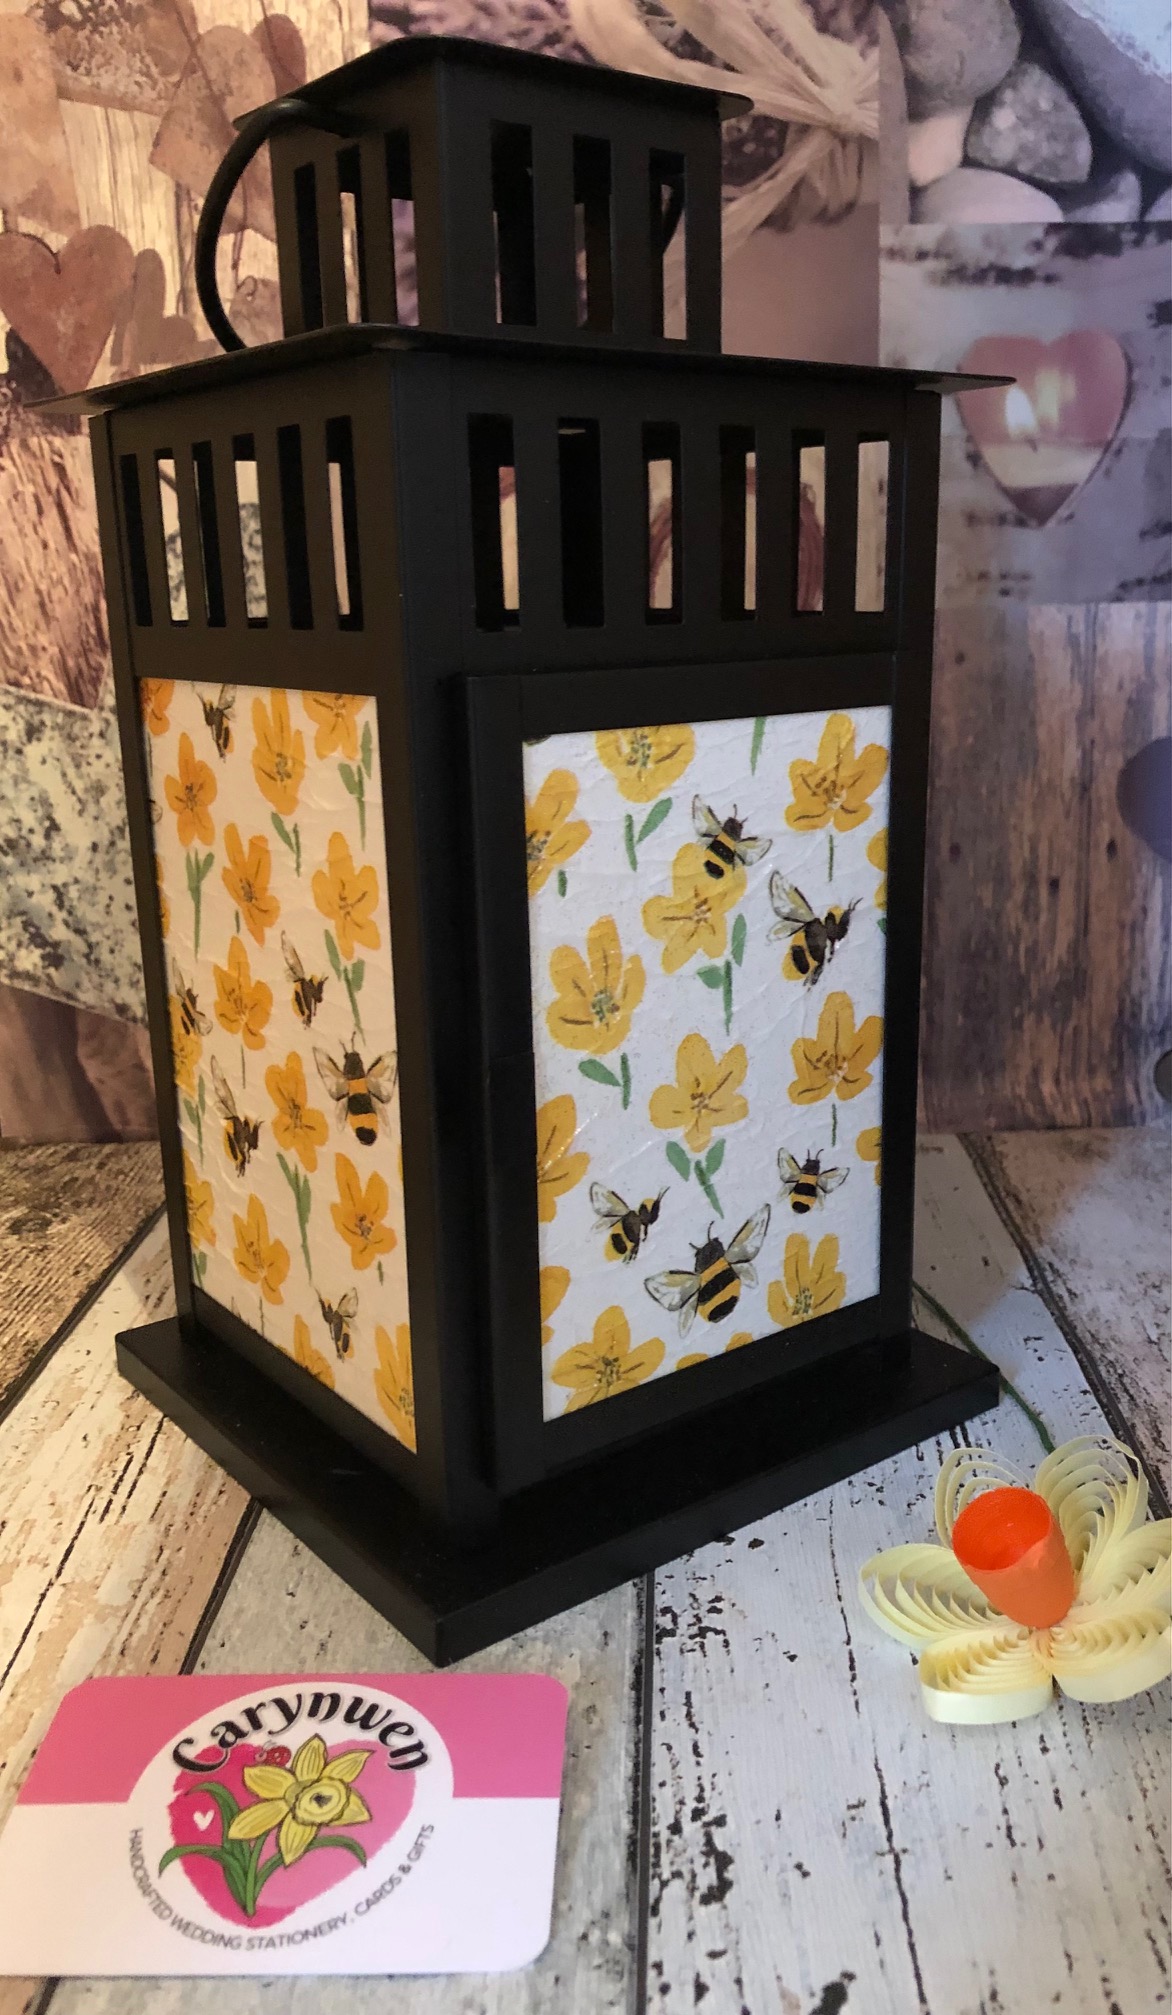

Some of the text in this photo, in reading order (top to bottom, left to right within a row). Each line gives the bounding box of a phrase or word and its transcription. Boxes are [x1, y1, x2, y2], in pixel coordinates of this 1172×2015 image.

[172, 1691, 429, 1772] Carynwen
[129, 1827, 174, 1921] HANDCRAFTED
[170, 1914, 242, 1951] WEDDING
[354, 1873, 402, 1917] CARDS
[398, 1864, 412, 1875] &
[407, 1824, 434, 1862] GIFTS
